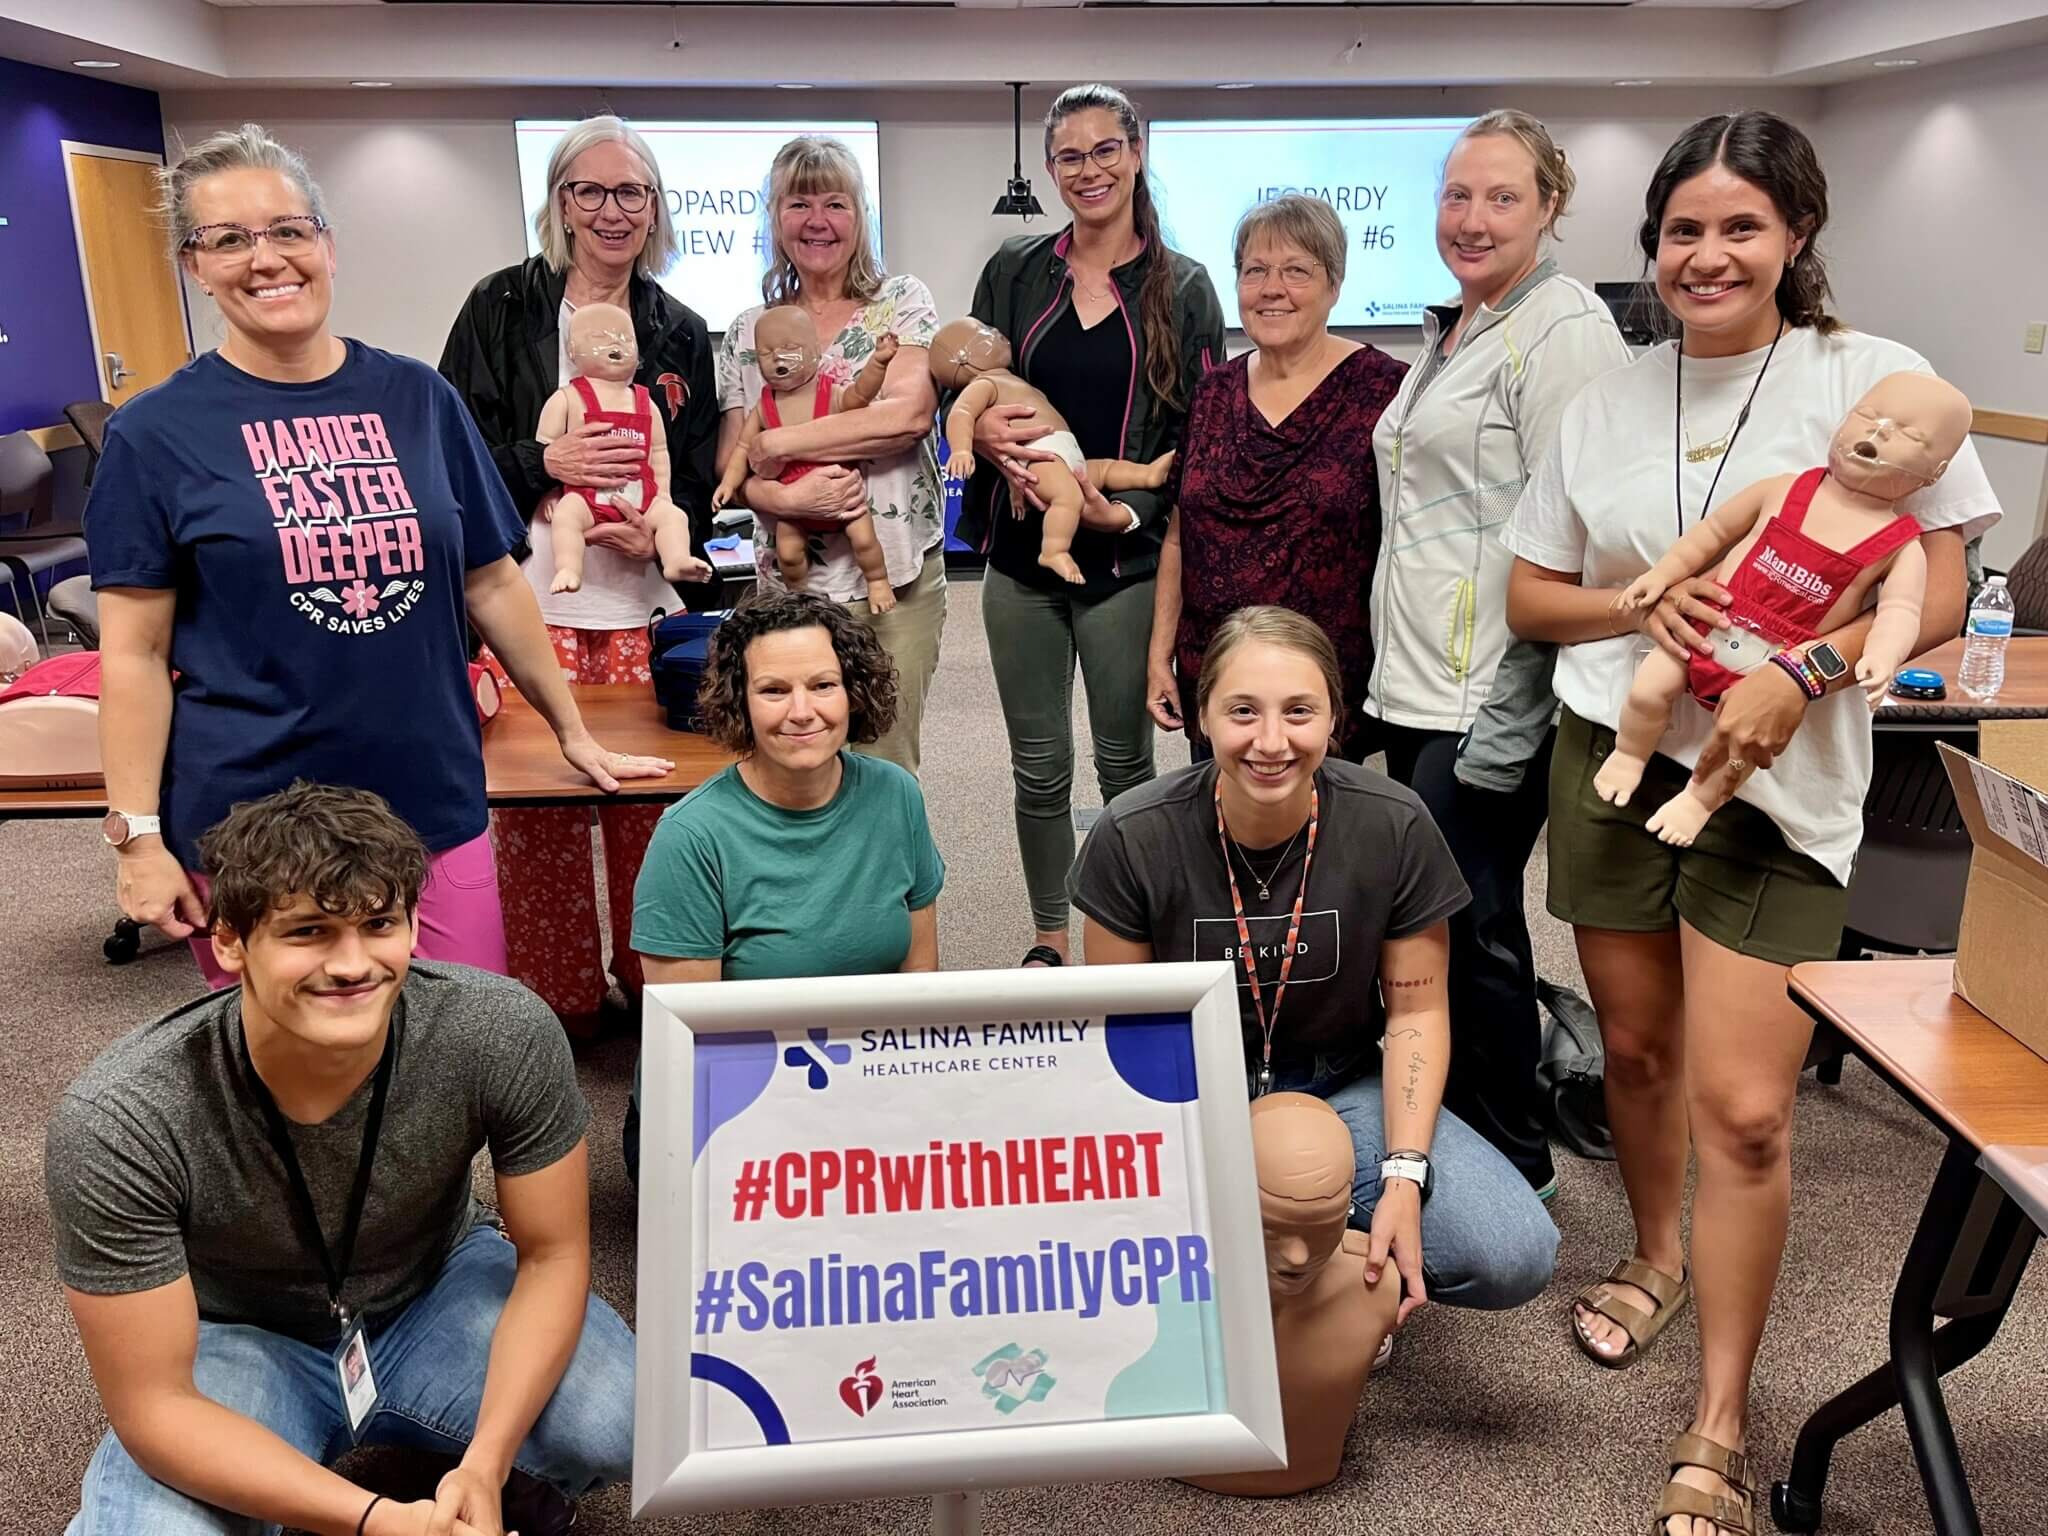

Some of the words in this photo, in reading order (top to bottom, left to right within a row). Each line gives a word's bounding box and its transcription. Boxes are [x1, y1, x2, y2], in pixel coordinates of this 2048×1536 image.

[675, 230, 735, 255] IEW
[1362, 225, 1395, 251] #6
[241, 413, 395, 471] HARDER
[261, 465, 414, 519] FASTER
[278, 518, 424, 584] DEEPER
[1759, 545, 1833, 596] ManiBibs
[289, 591, 324, 625] CPR
[327, 616, 386, 635] SAVES
[387, 579, 425, 623] LIVES
[861, 1025, 972, 1052] SALINA
[982, 1019, 1090, 1046] FAMILY
[863, 1059, 982, 1077] HEALTHCARE
[988, 1055, 1058, 1071] CENTER
[733, 1132, 1163, 1222] #CPRwithHEART
[695, 1235, 1212, 1335] #SalinaFamilyCPR
[891, 1379, 937, 1389] American
[891, 1389, 919, 1399] Heart
